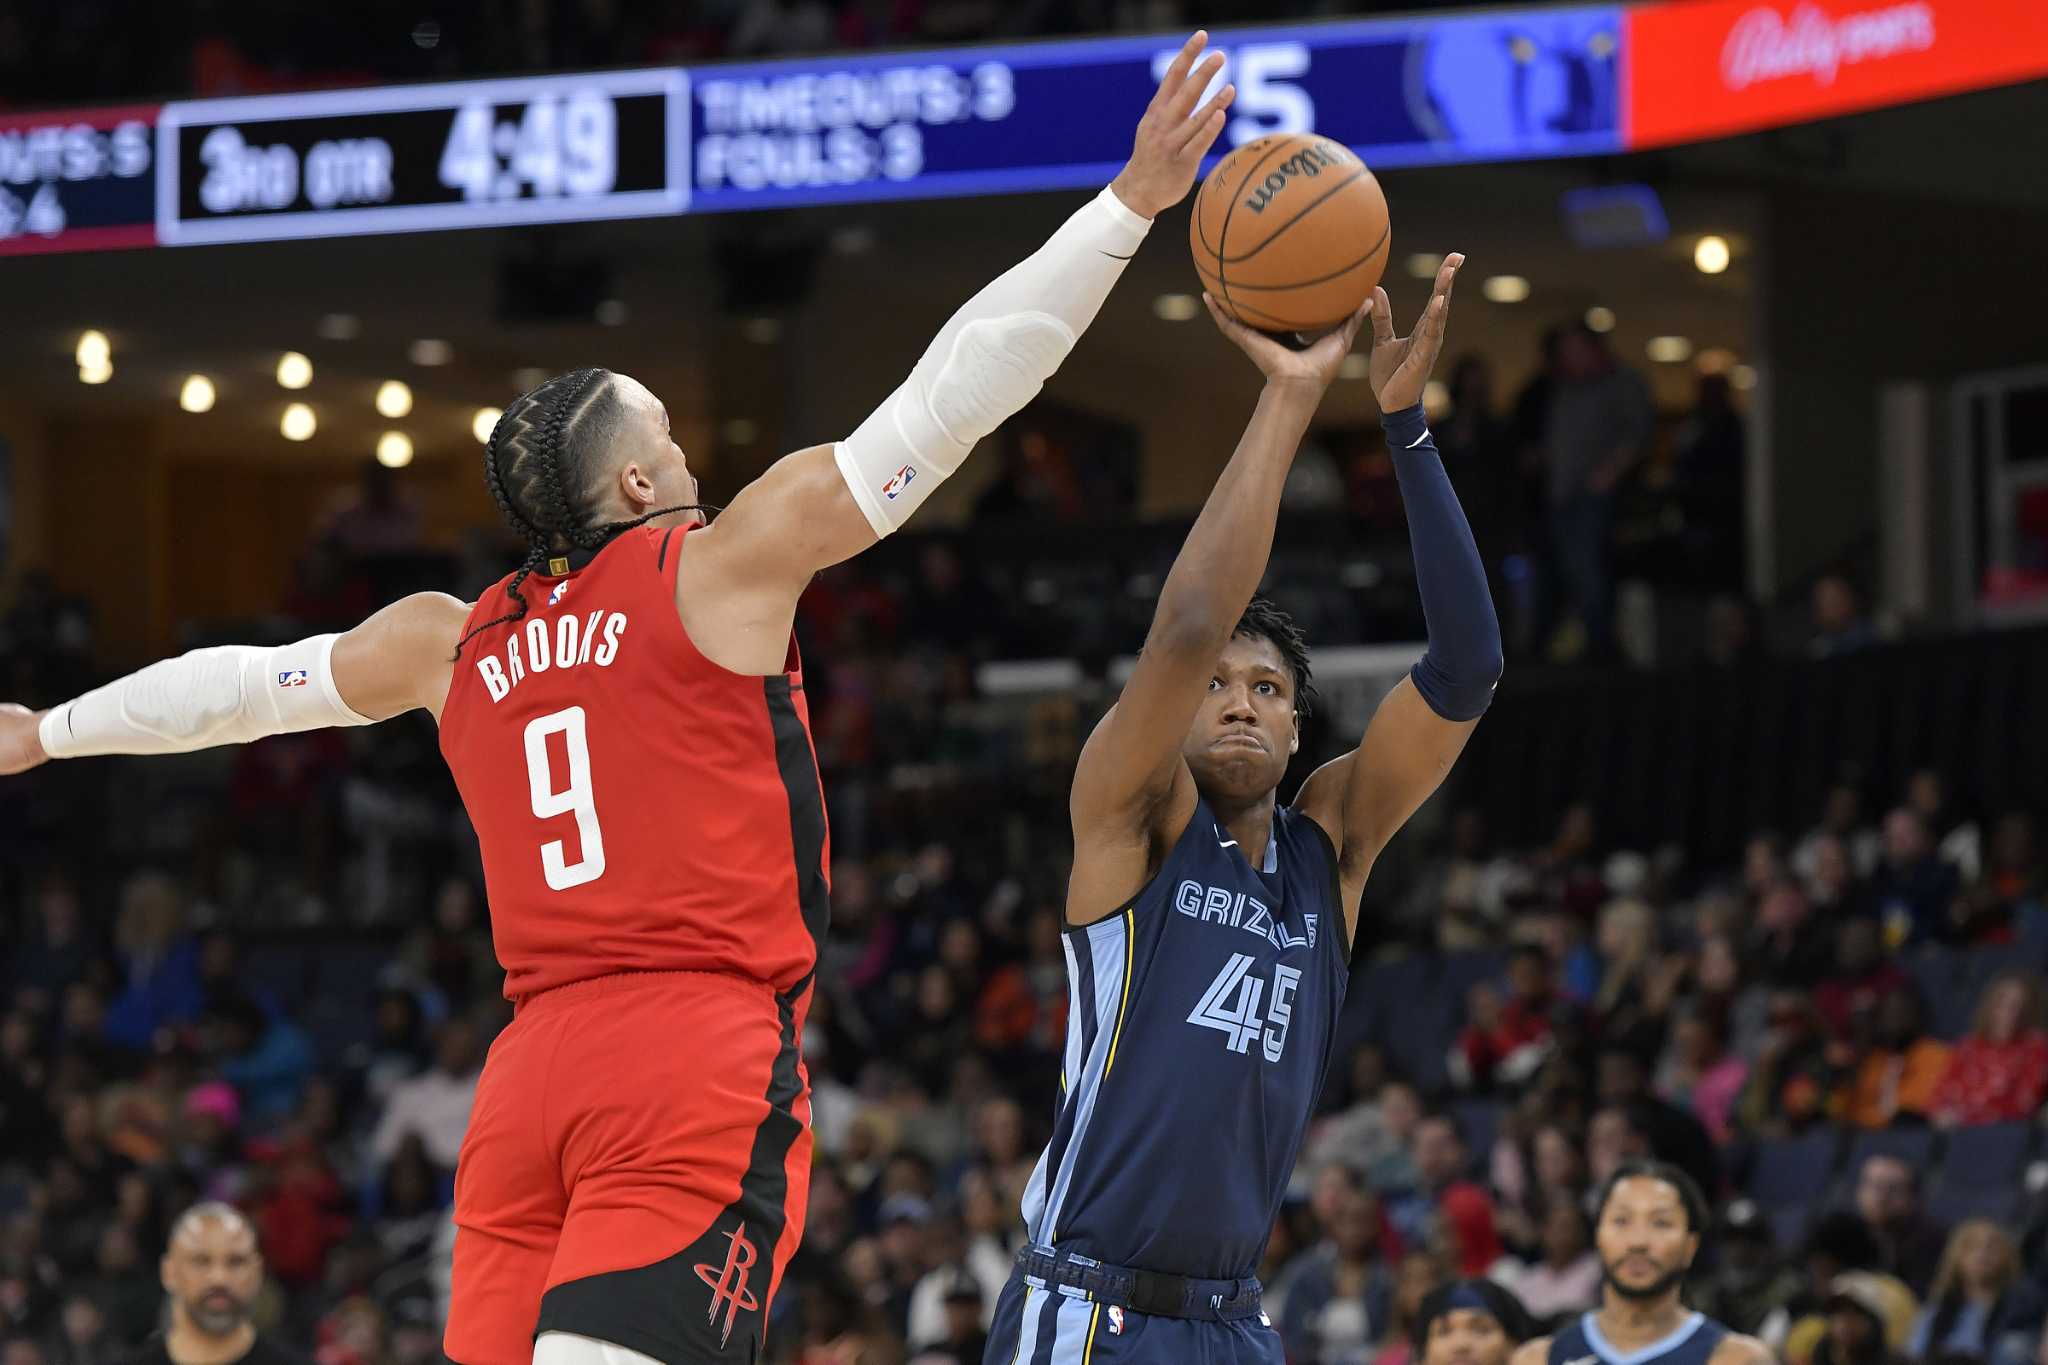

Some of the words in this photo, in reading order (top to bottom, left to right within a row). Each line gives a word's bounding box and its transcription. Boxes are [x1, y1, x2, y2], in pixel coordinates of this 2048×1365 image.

[438, 91, 618, 202] 4:49
[476, 610, 627, 703] BROOKS
[524, 705, 606, 891] 9
[1186, 952, 1303, 1063] 45
